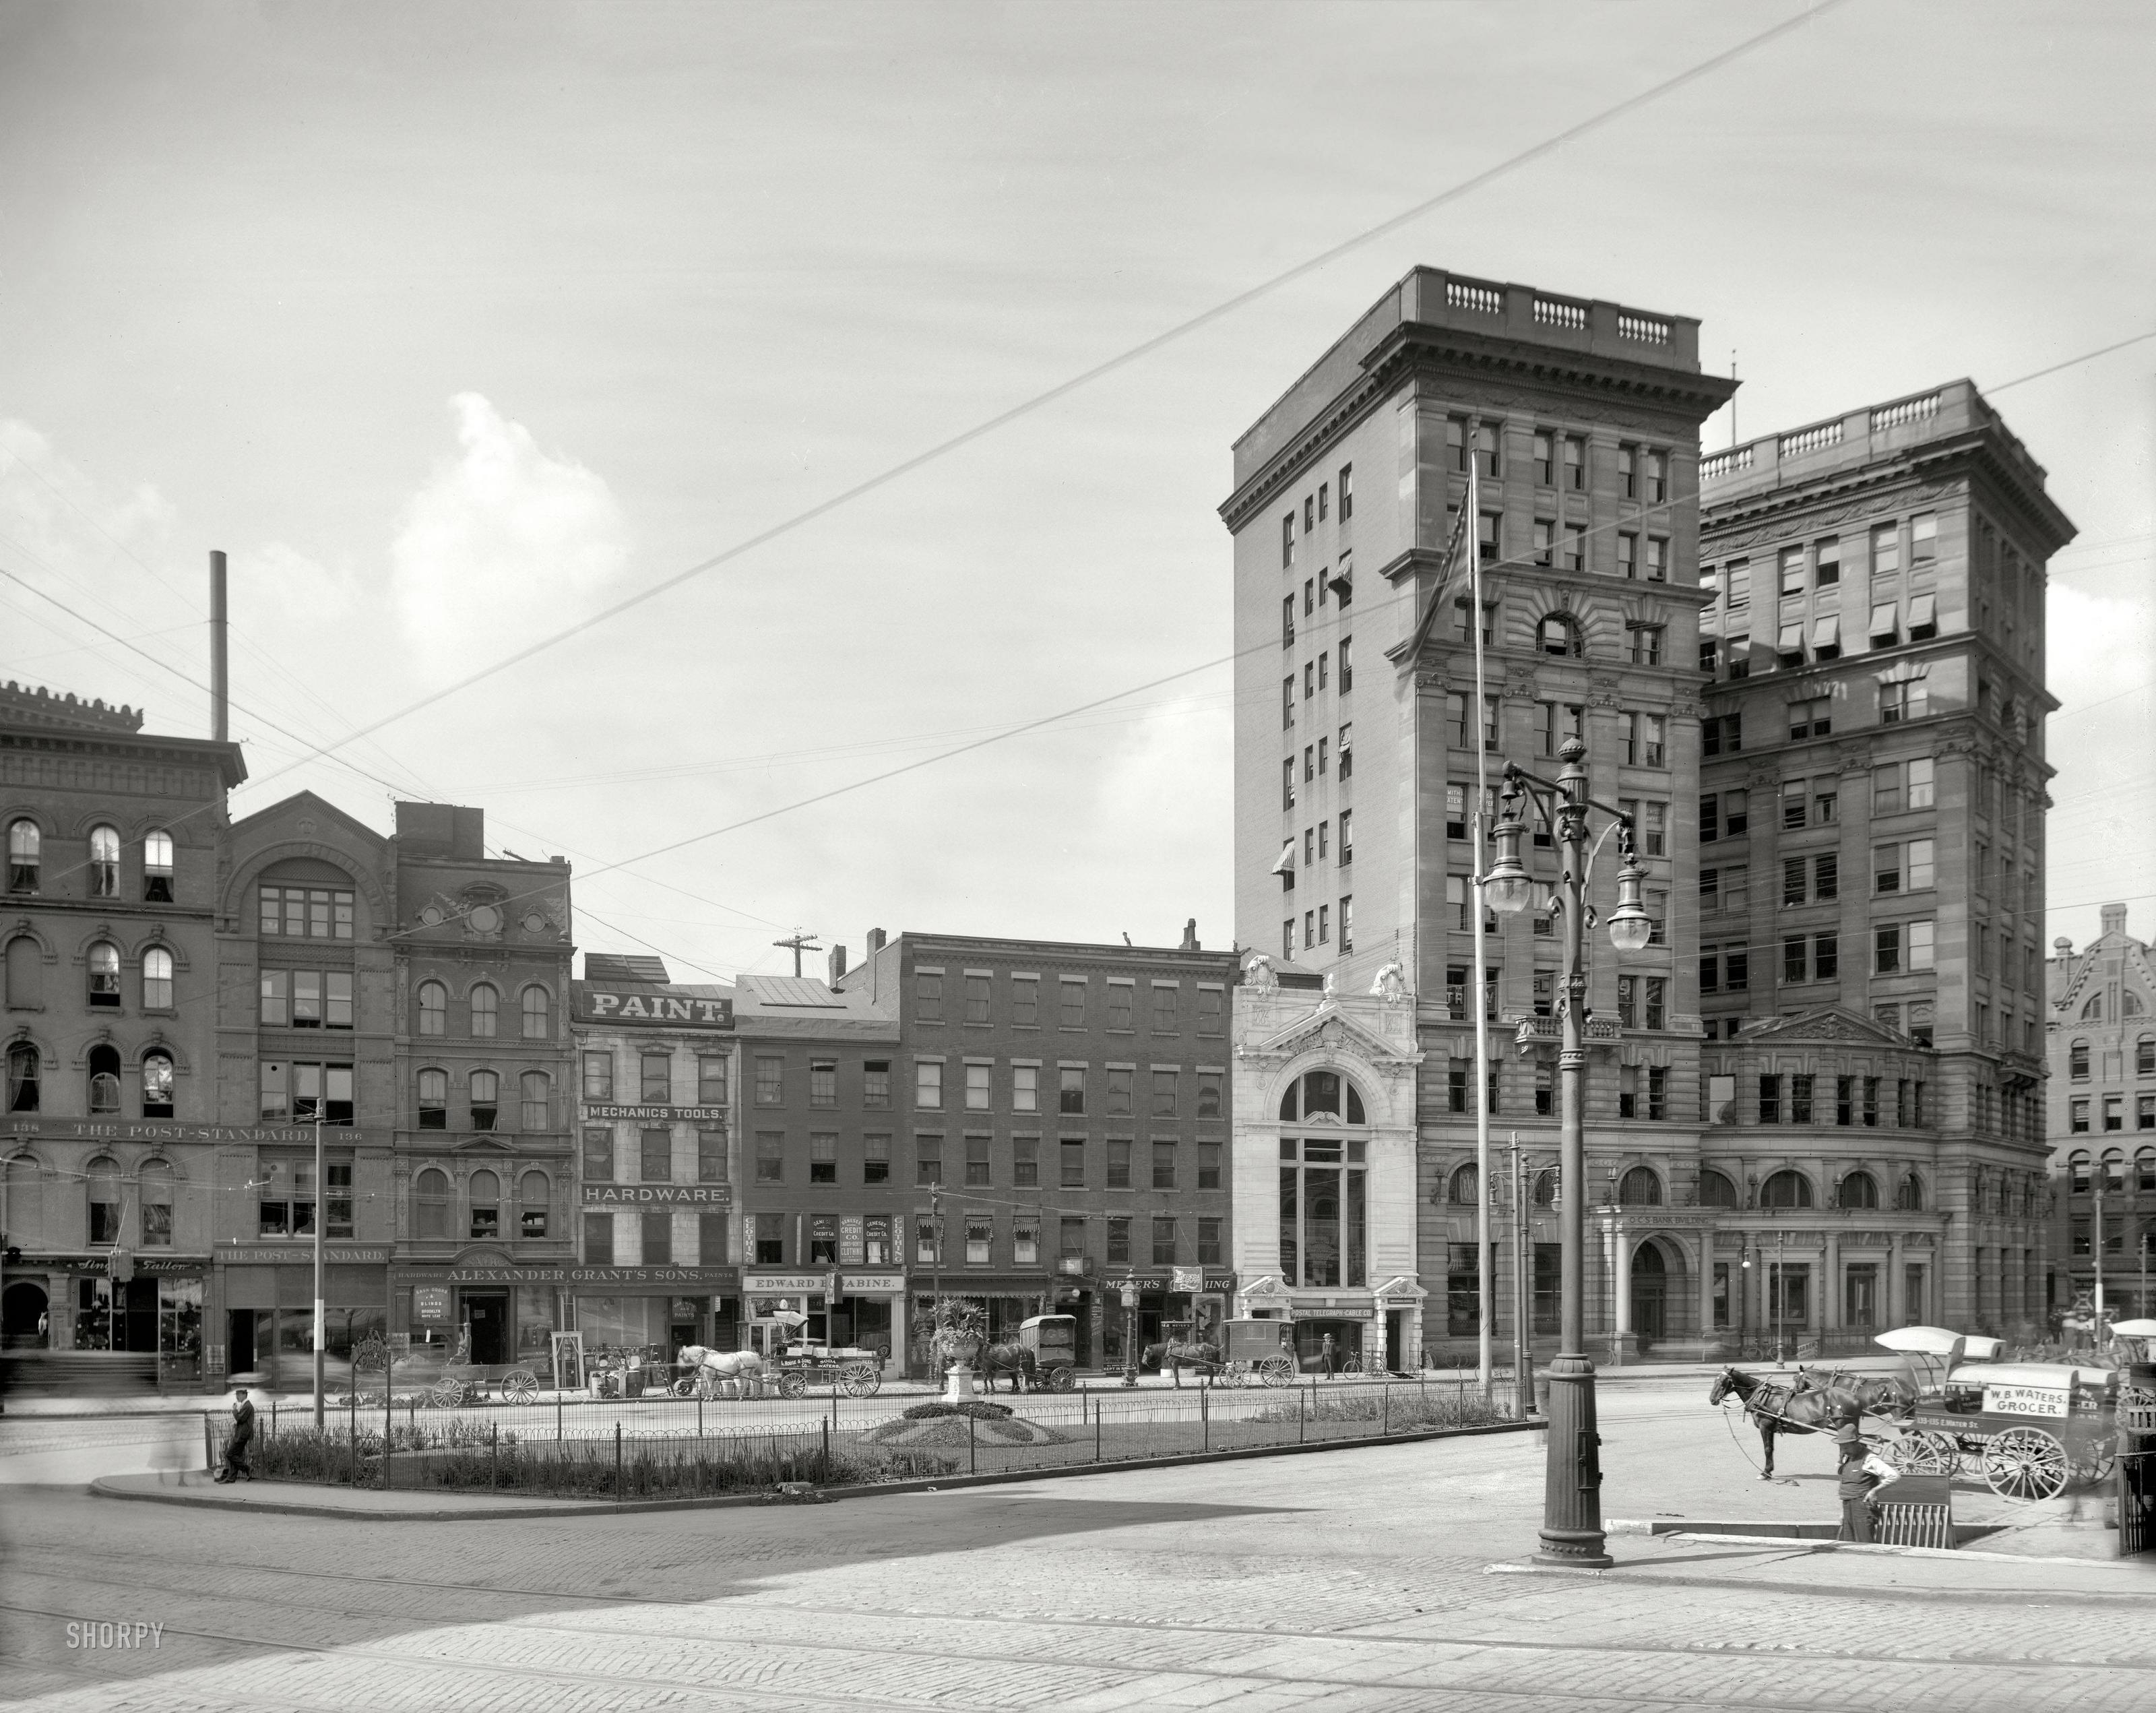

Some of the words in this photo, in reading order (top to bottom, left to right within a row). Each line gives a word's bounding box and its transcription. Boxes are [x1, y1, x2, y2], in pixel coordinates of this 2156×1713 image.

[592, 994, 725, 1022] PAINT.
[590, 1107, 668, 1119] MECHANICS
[675, 1109, 722, 1119] TOOLS.
[74, 1125, 117, 1137] THE
[585, 1188, 730, 1202] HARDWARE.
[745, 1217, 754, 1262] CLOTHING
[894, 1217, 902, 1262] CLOTHING
[217, 1251, 248, 1260] THE
[447, 1270, 564, 1280] ALEXANDER
[572, 1270, 647, 1280] GRANT'S
[655, 1270, 703, 1280] SONS.
[1105, 1280, 1161, 1289] MEER'S
[2015, 1390, 2066, 1404] WATERS.
[1998, 1400, 2062, 1414] GROCER.
